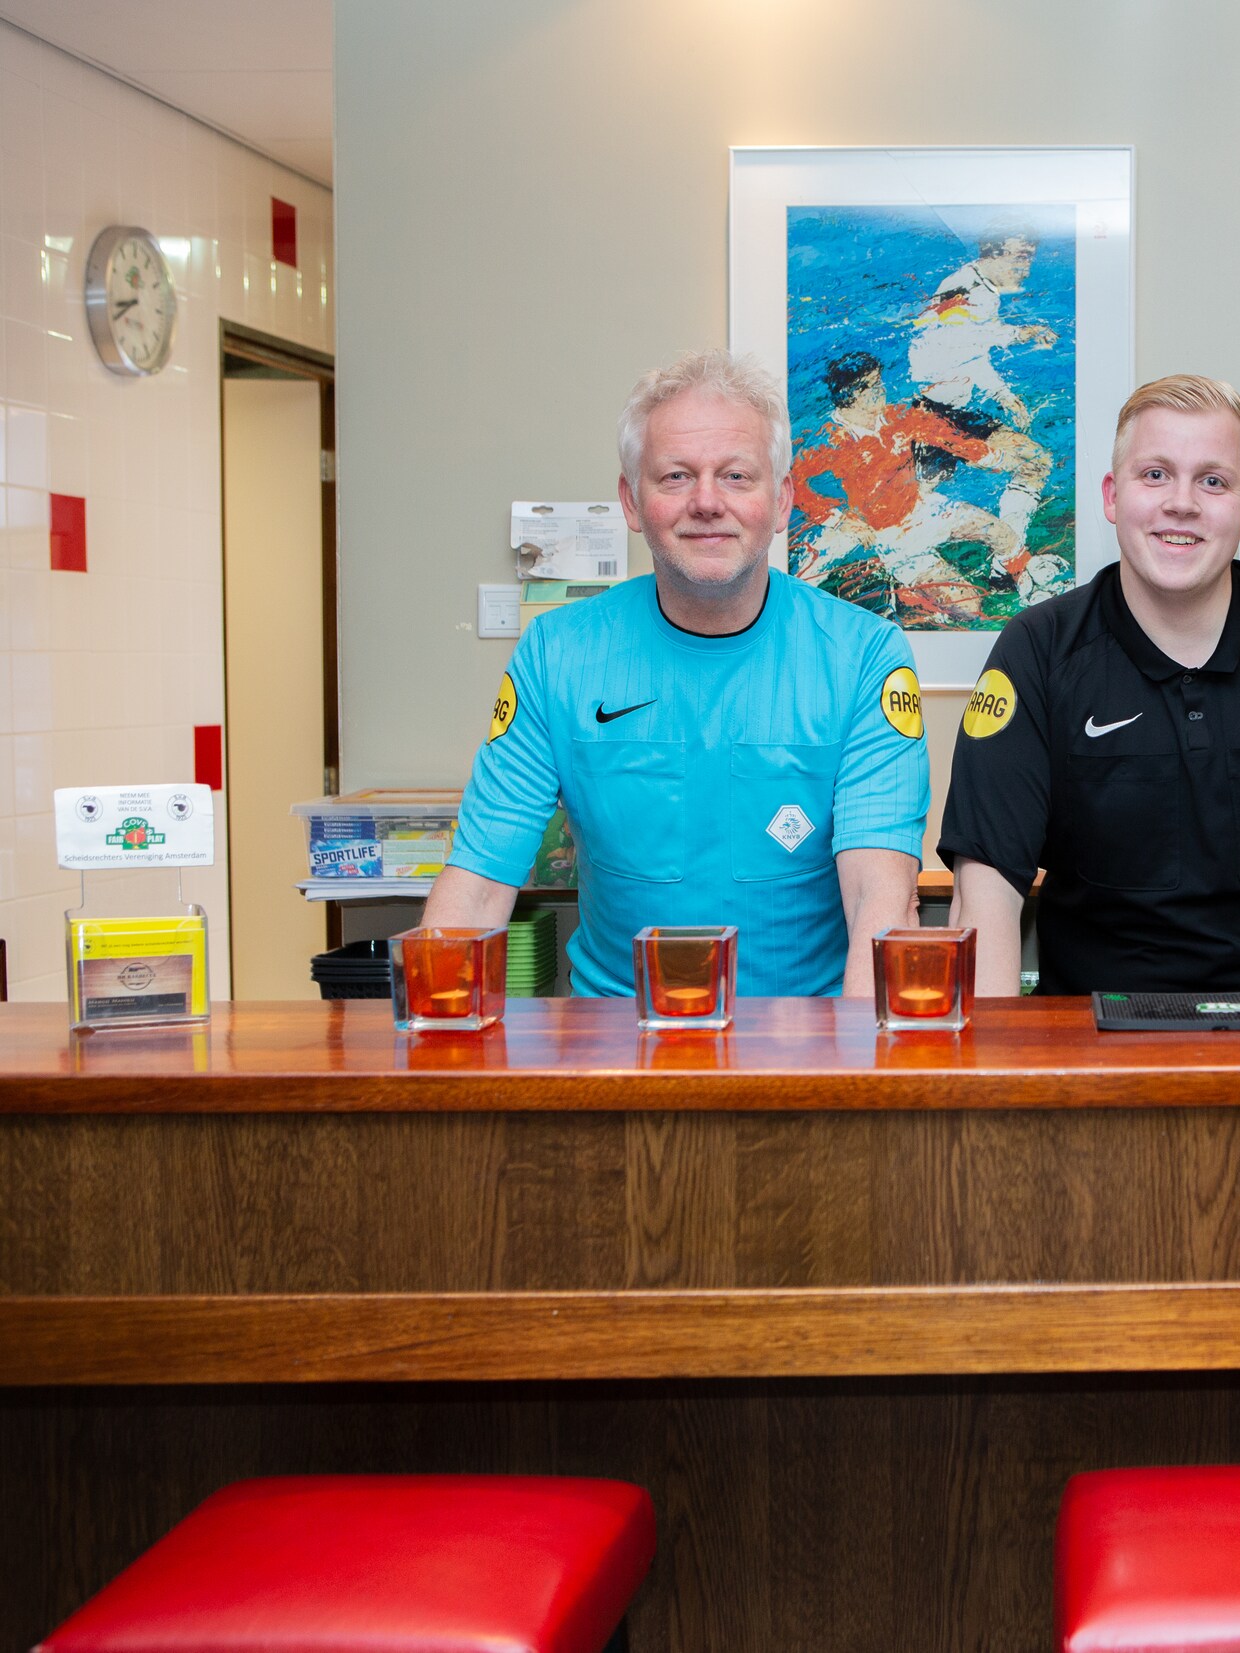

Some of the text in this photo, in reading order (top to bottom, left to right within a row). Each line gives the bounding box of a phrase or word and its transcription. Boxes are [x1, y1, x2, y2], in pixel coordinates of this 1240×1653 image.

[494, 698, 510, 722] AG
[889, 690, 921, 714] ARA
[967, 691, 1008, 718] ARAG
[123, 819, 147, 829] COVS
[108, 834, 164, 843] FAIR PLAY
[64, 852, 207, 862] Scheidsrechters Vereniging Amsterdam
[313, 846, 376, 865] SPORTLIFE
